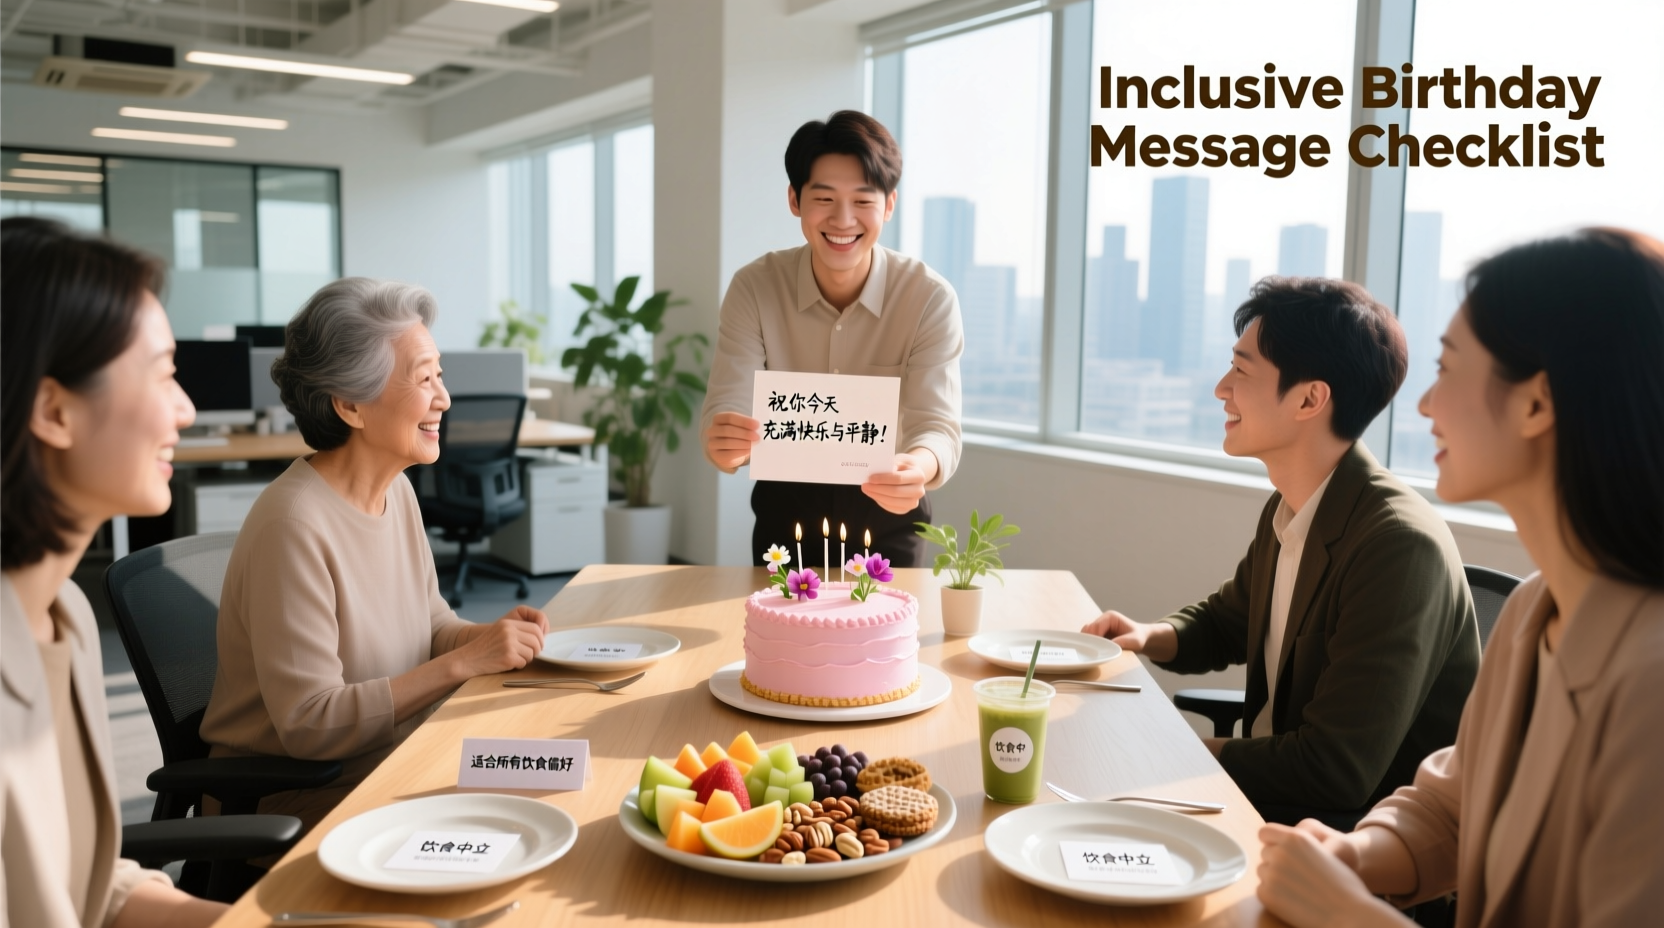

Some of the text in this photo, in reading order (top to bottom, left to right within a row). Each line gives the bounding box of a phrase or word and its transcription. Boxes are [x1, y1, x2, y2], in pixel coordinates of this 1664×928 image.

[767, 390, 840, 414] 祝你今天
[420, 840, 491, 855] 饮食中立
[1082, 851, 1155, 866] 饮食中立
